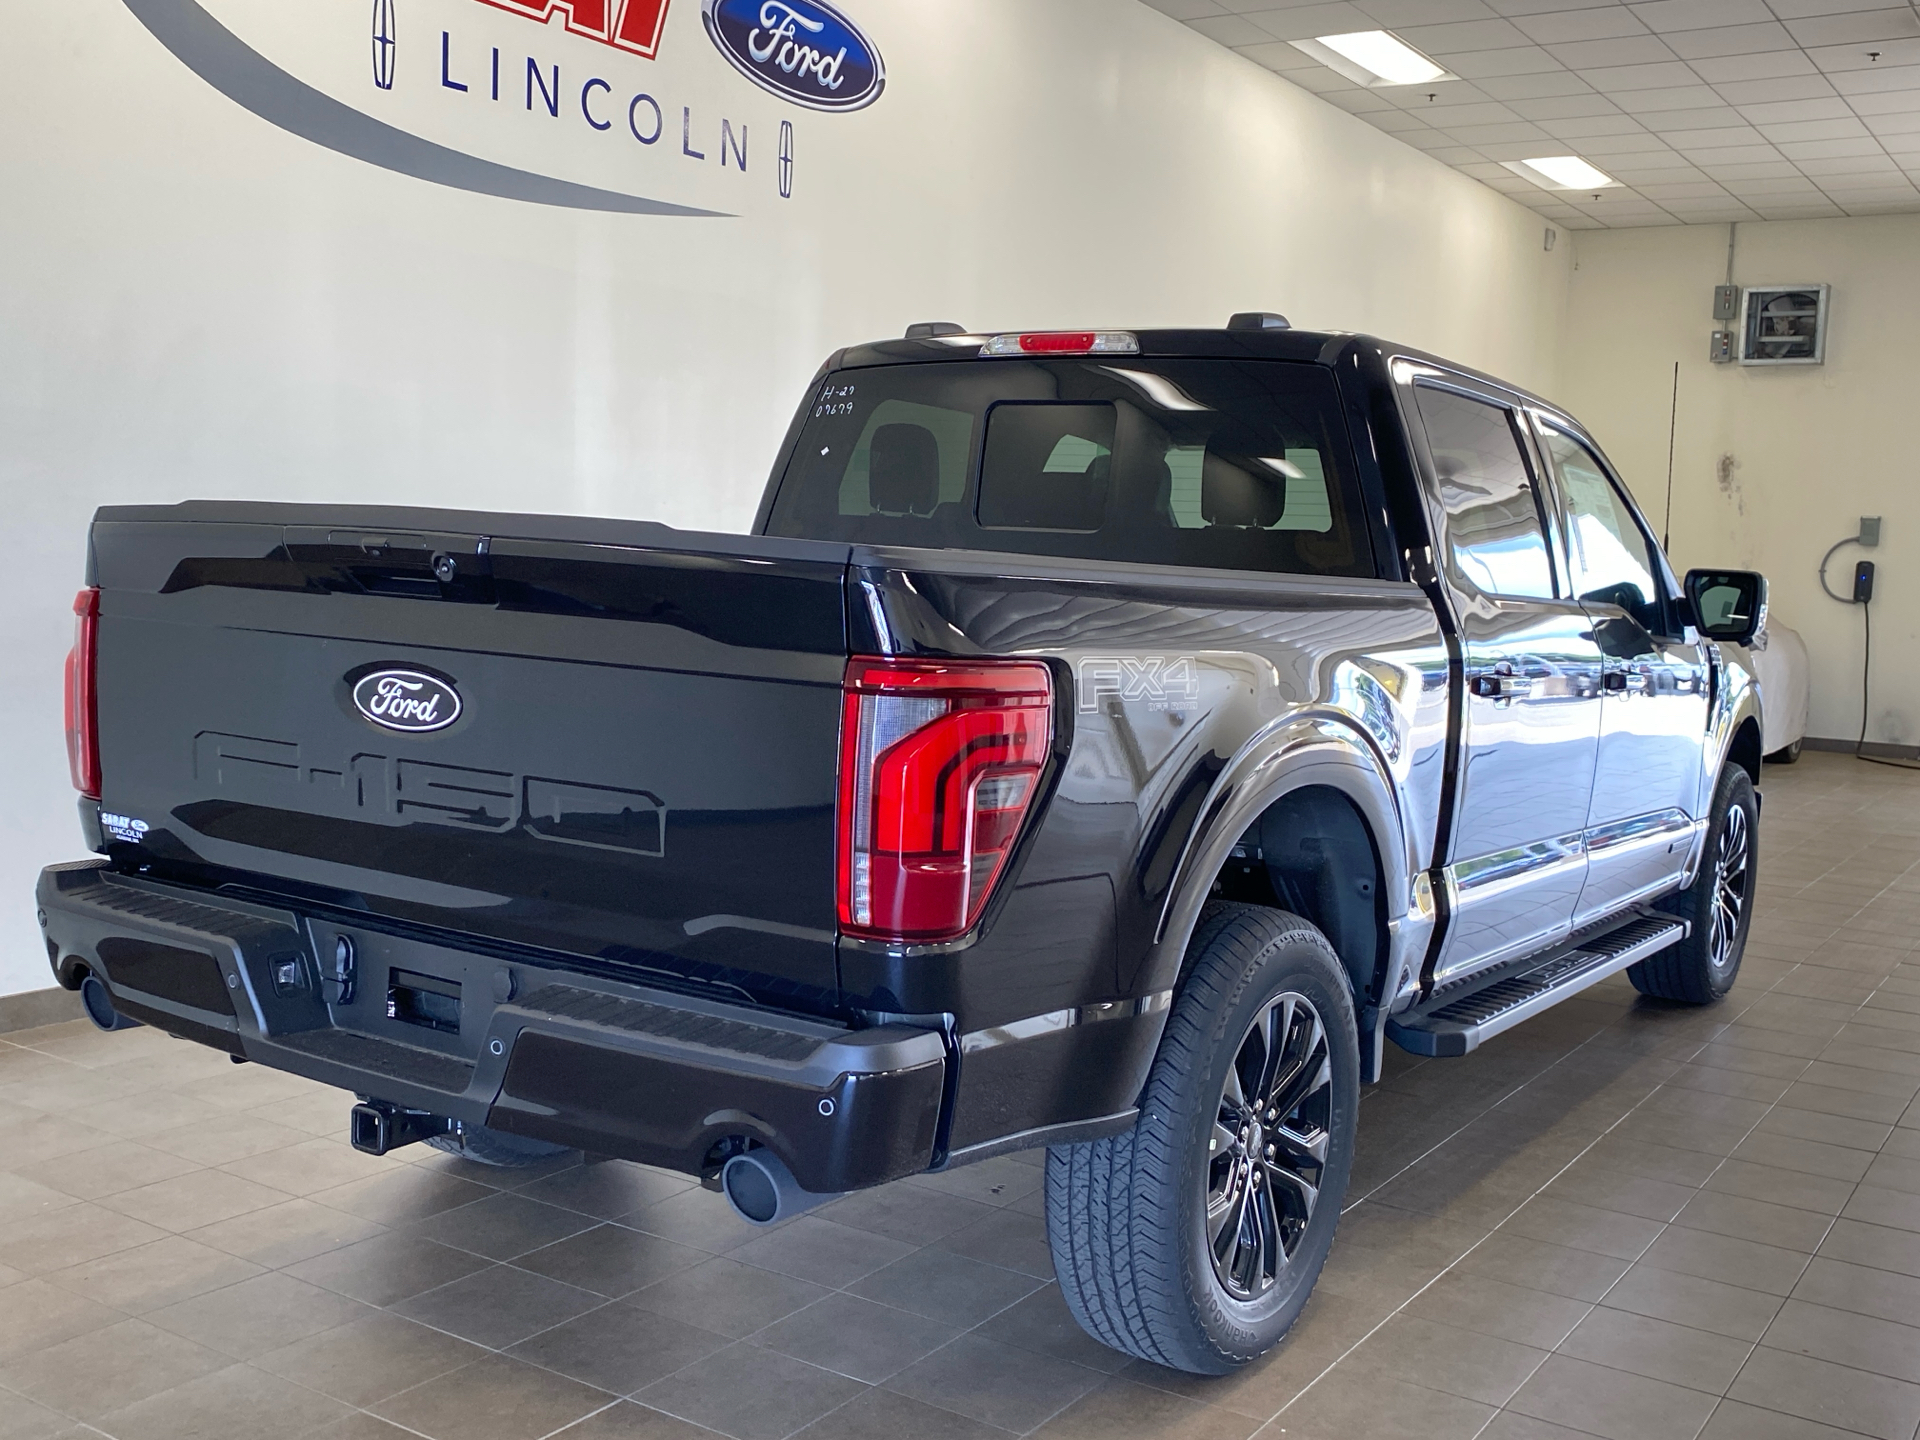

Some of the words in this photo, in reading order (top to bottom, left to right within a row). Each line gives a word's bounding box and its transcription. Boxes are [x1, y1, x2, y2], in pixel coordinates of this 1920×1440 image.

[747, 0, 846, 90] Ford
[441, 30, 748, 172] LINCOLN
[370, 677, 440, 722] Ford
[1077, 656, 1199, 714] FX4
[193, 730, 664, 857] F-150
[109, 825, 143, 839] LINCOLN
